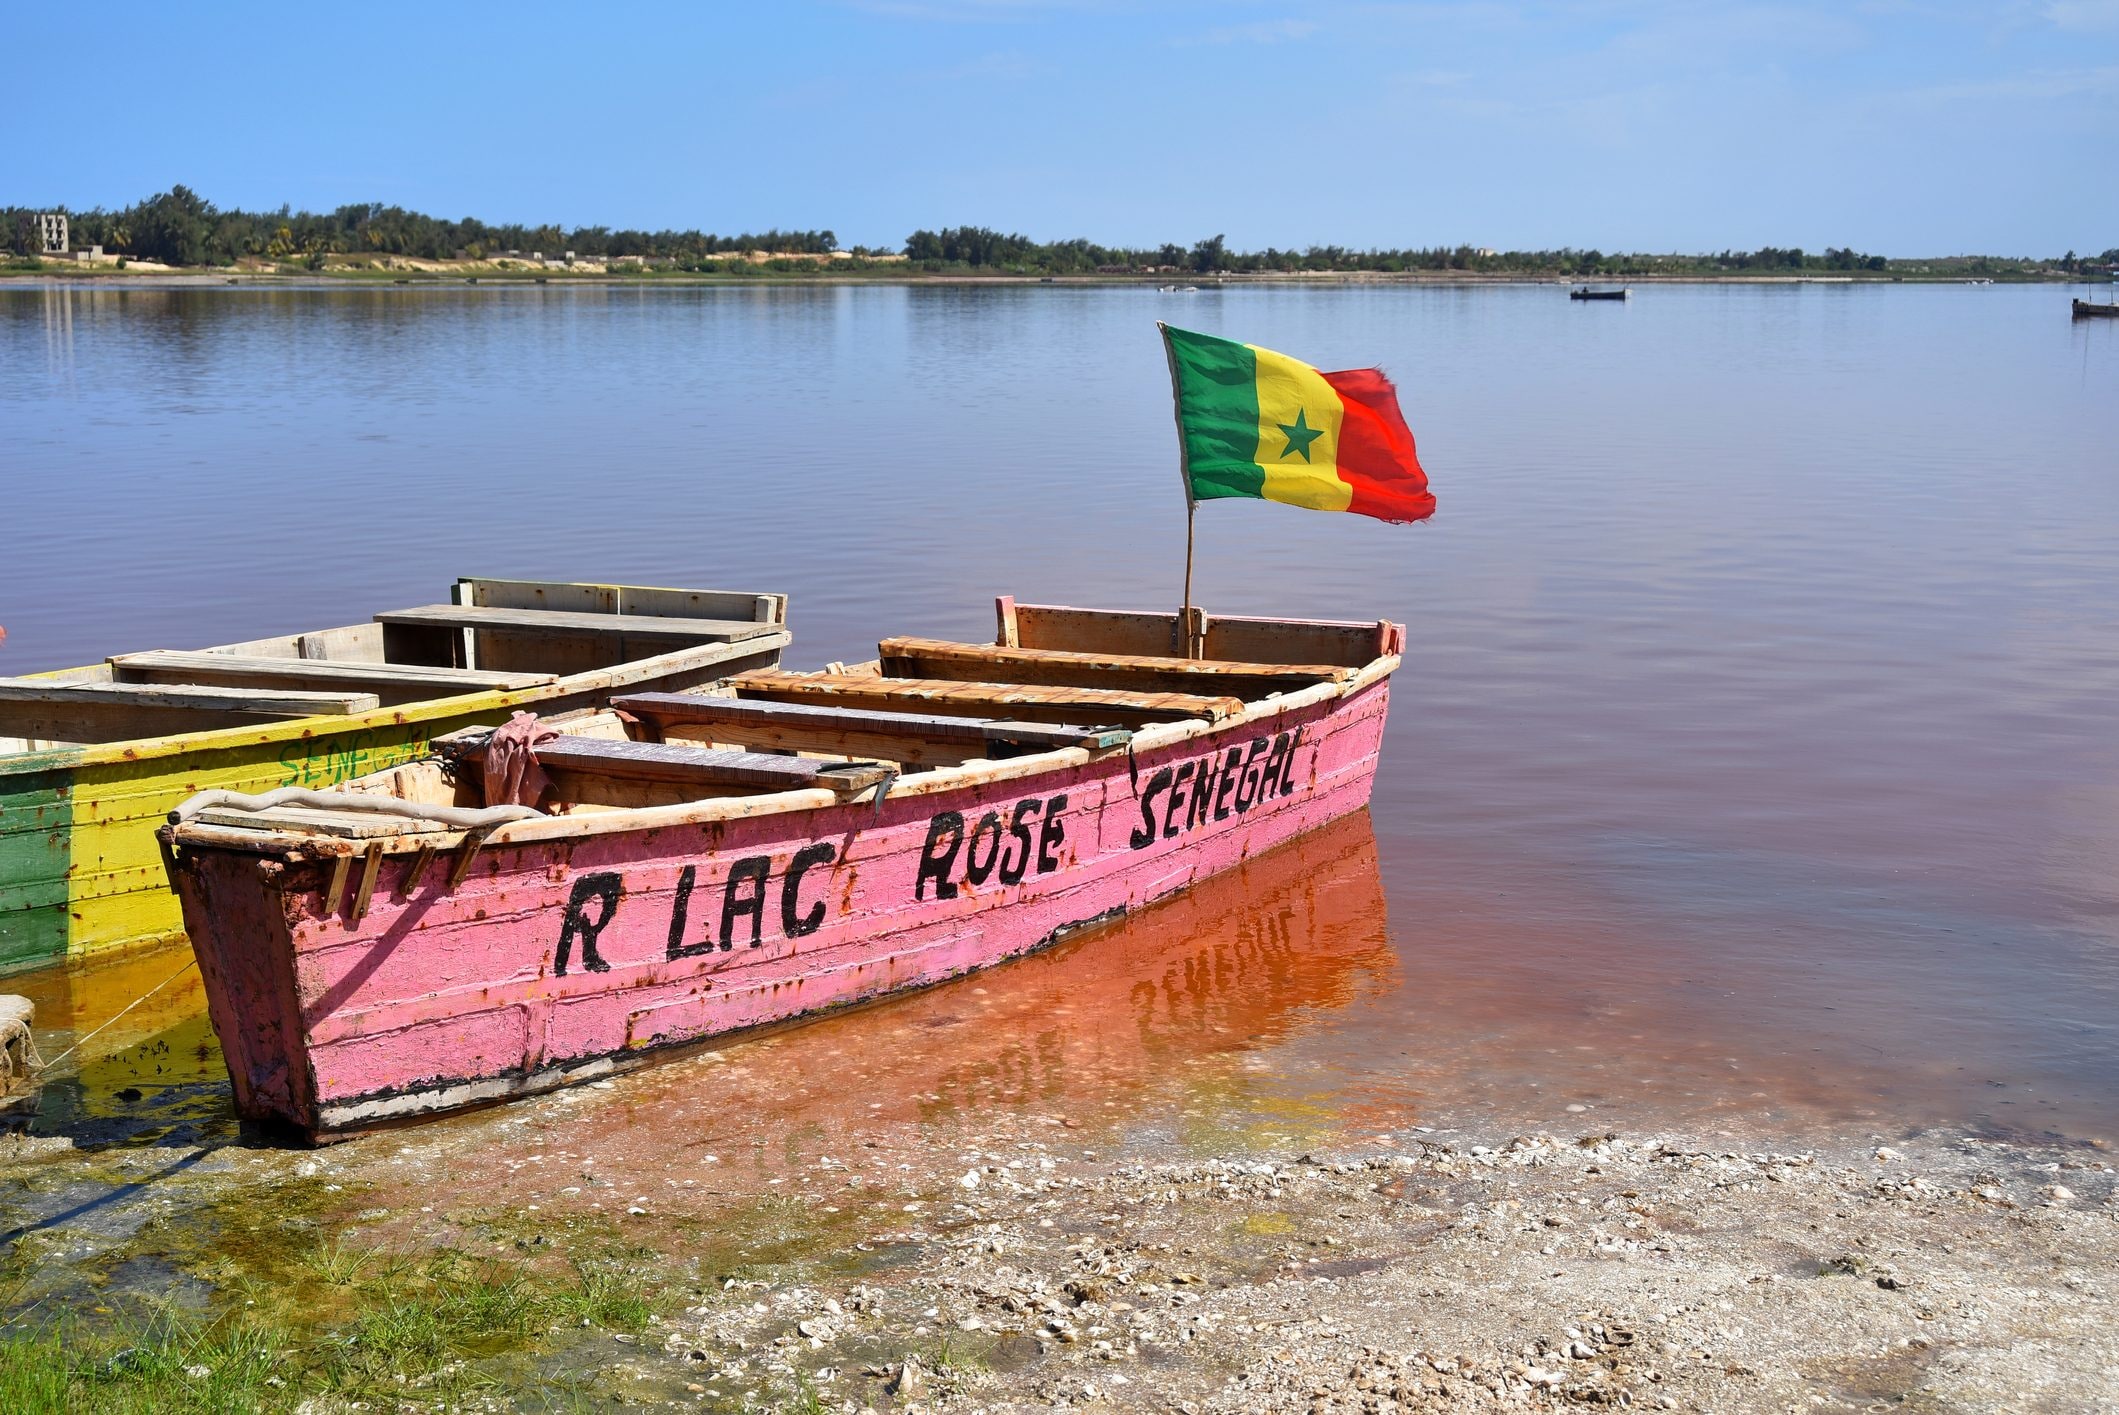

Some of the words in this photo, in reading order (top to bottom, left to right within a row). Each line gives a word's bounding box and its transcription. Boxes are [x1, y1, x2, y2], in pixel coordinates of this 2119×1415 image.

[553, 871, 623, 978] R
[665, 841, 837, 962] LAC
[914, 793, 1069, 902] ROSE
[1129, 725, 1304, 850] SENEGAL
